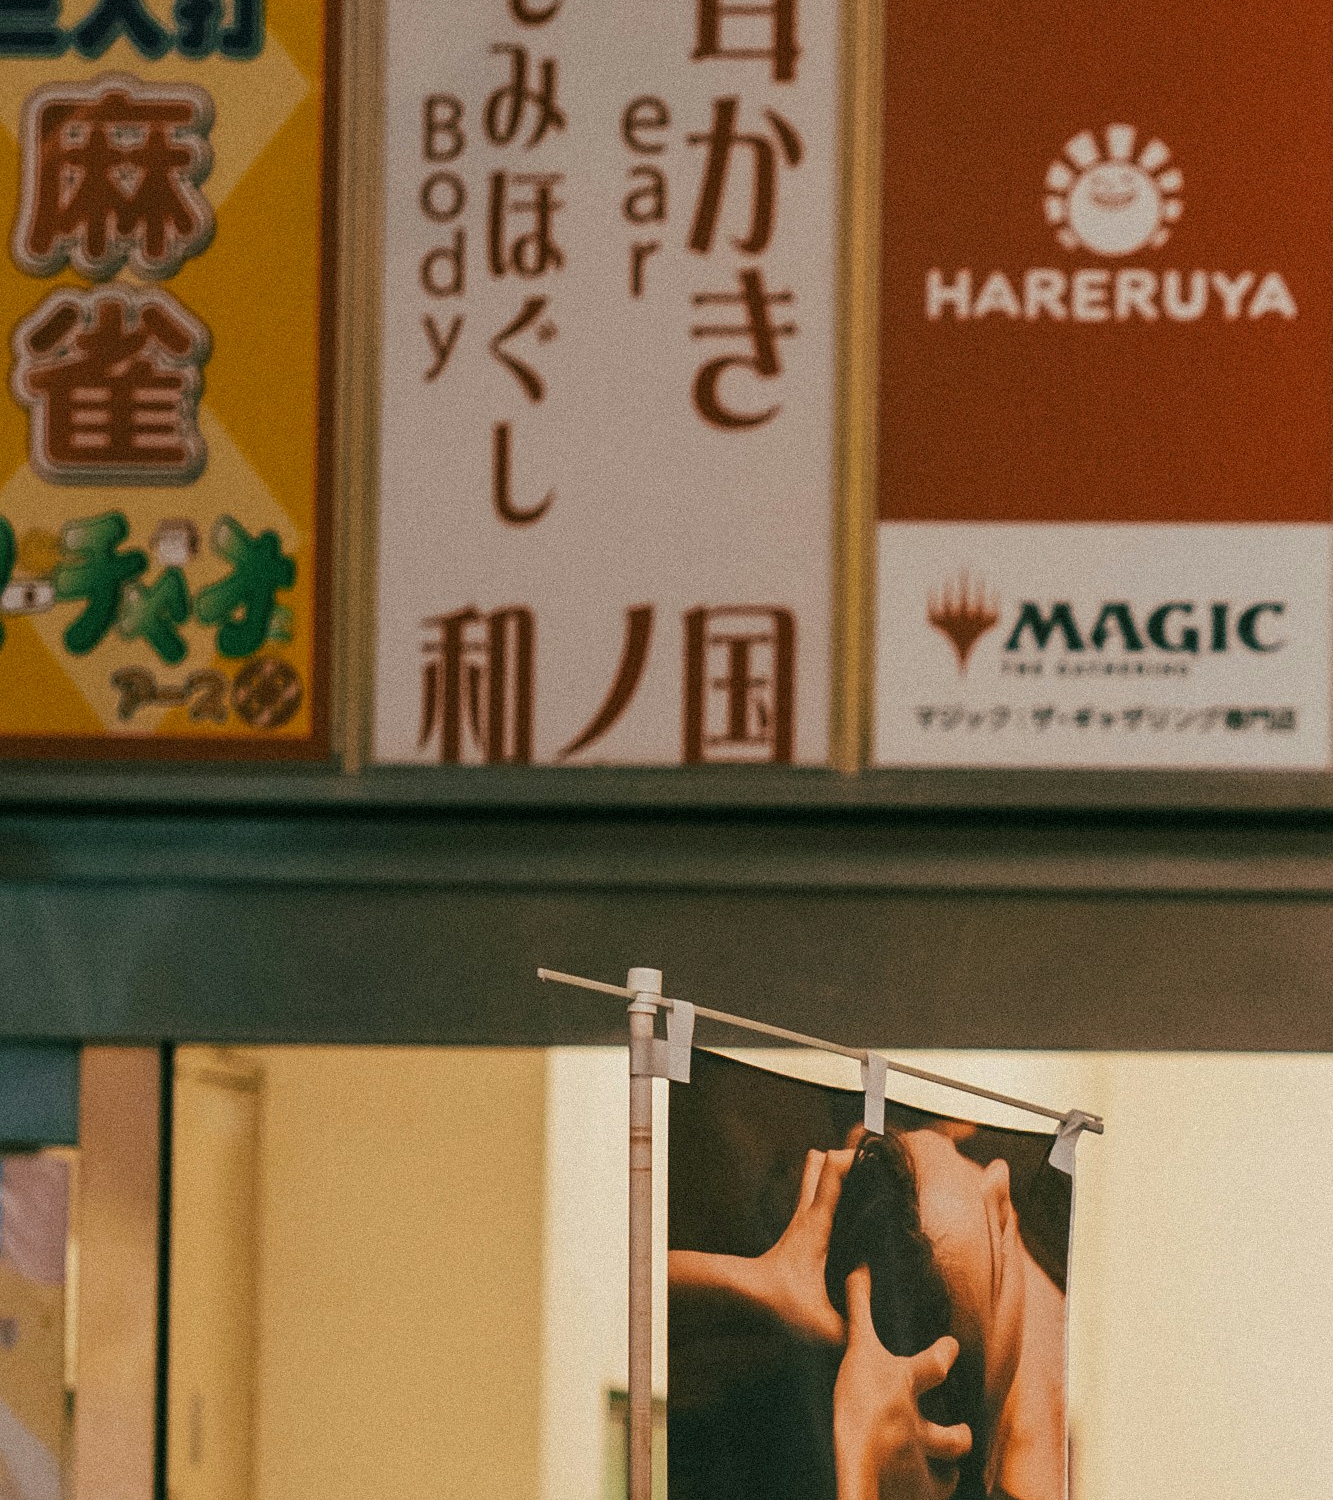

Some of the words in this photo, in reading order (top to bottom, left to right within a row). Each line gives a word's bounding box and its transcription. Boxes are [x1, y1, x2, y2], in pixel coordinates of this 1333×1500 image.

[12, 73, 215, 485] 麻雀
[419, 94, 469, 382] Body
[620, 91, 673, 299] ear
[923, 267, 1298, 323] HARERUYA
[1003, 600, 1287, 654] MAGIC
